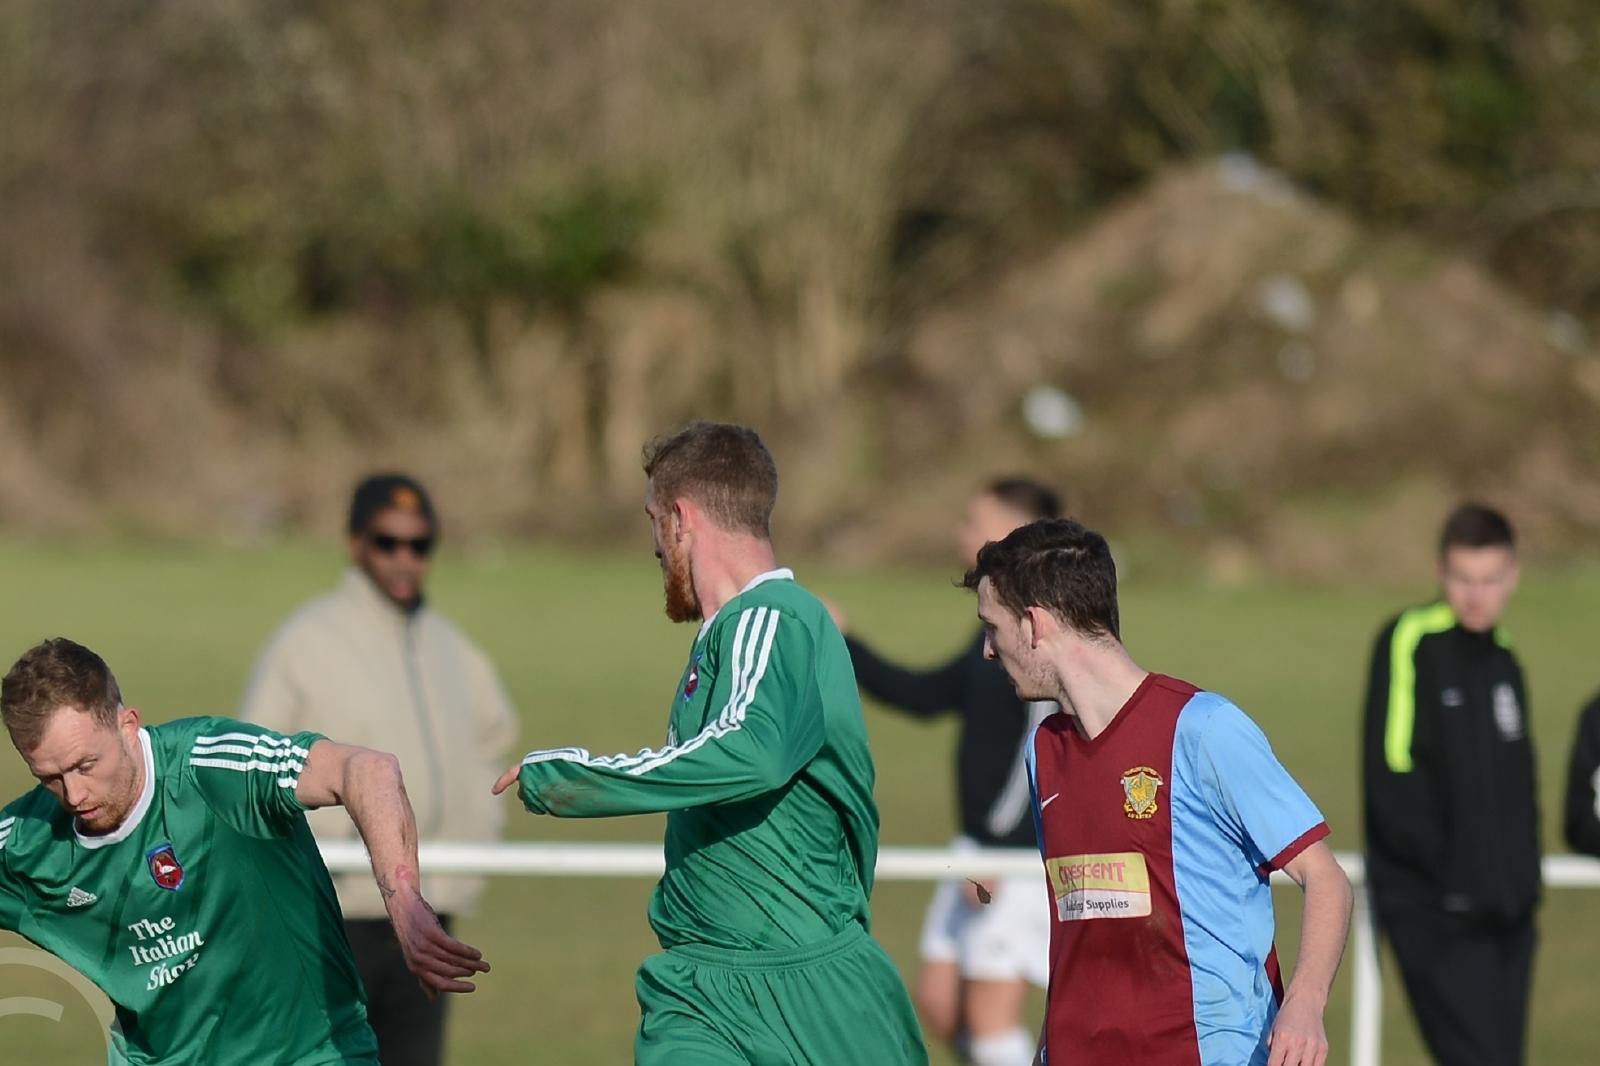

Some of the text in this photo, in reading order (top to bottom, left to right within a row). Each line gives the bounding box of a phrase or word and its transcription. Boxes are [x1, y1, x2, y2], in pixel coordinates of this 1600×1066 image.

[1086, 898, 1129, 912] Supplies
[128, 916, 176, 941] The
[128, 930, 204, 967] Italian
